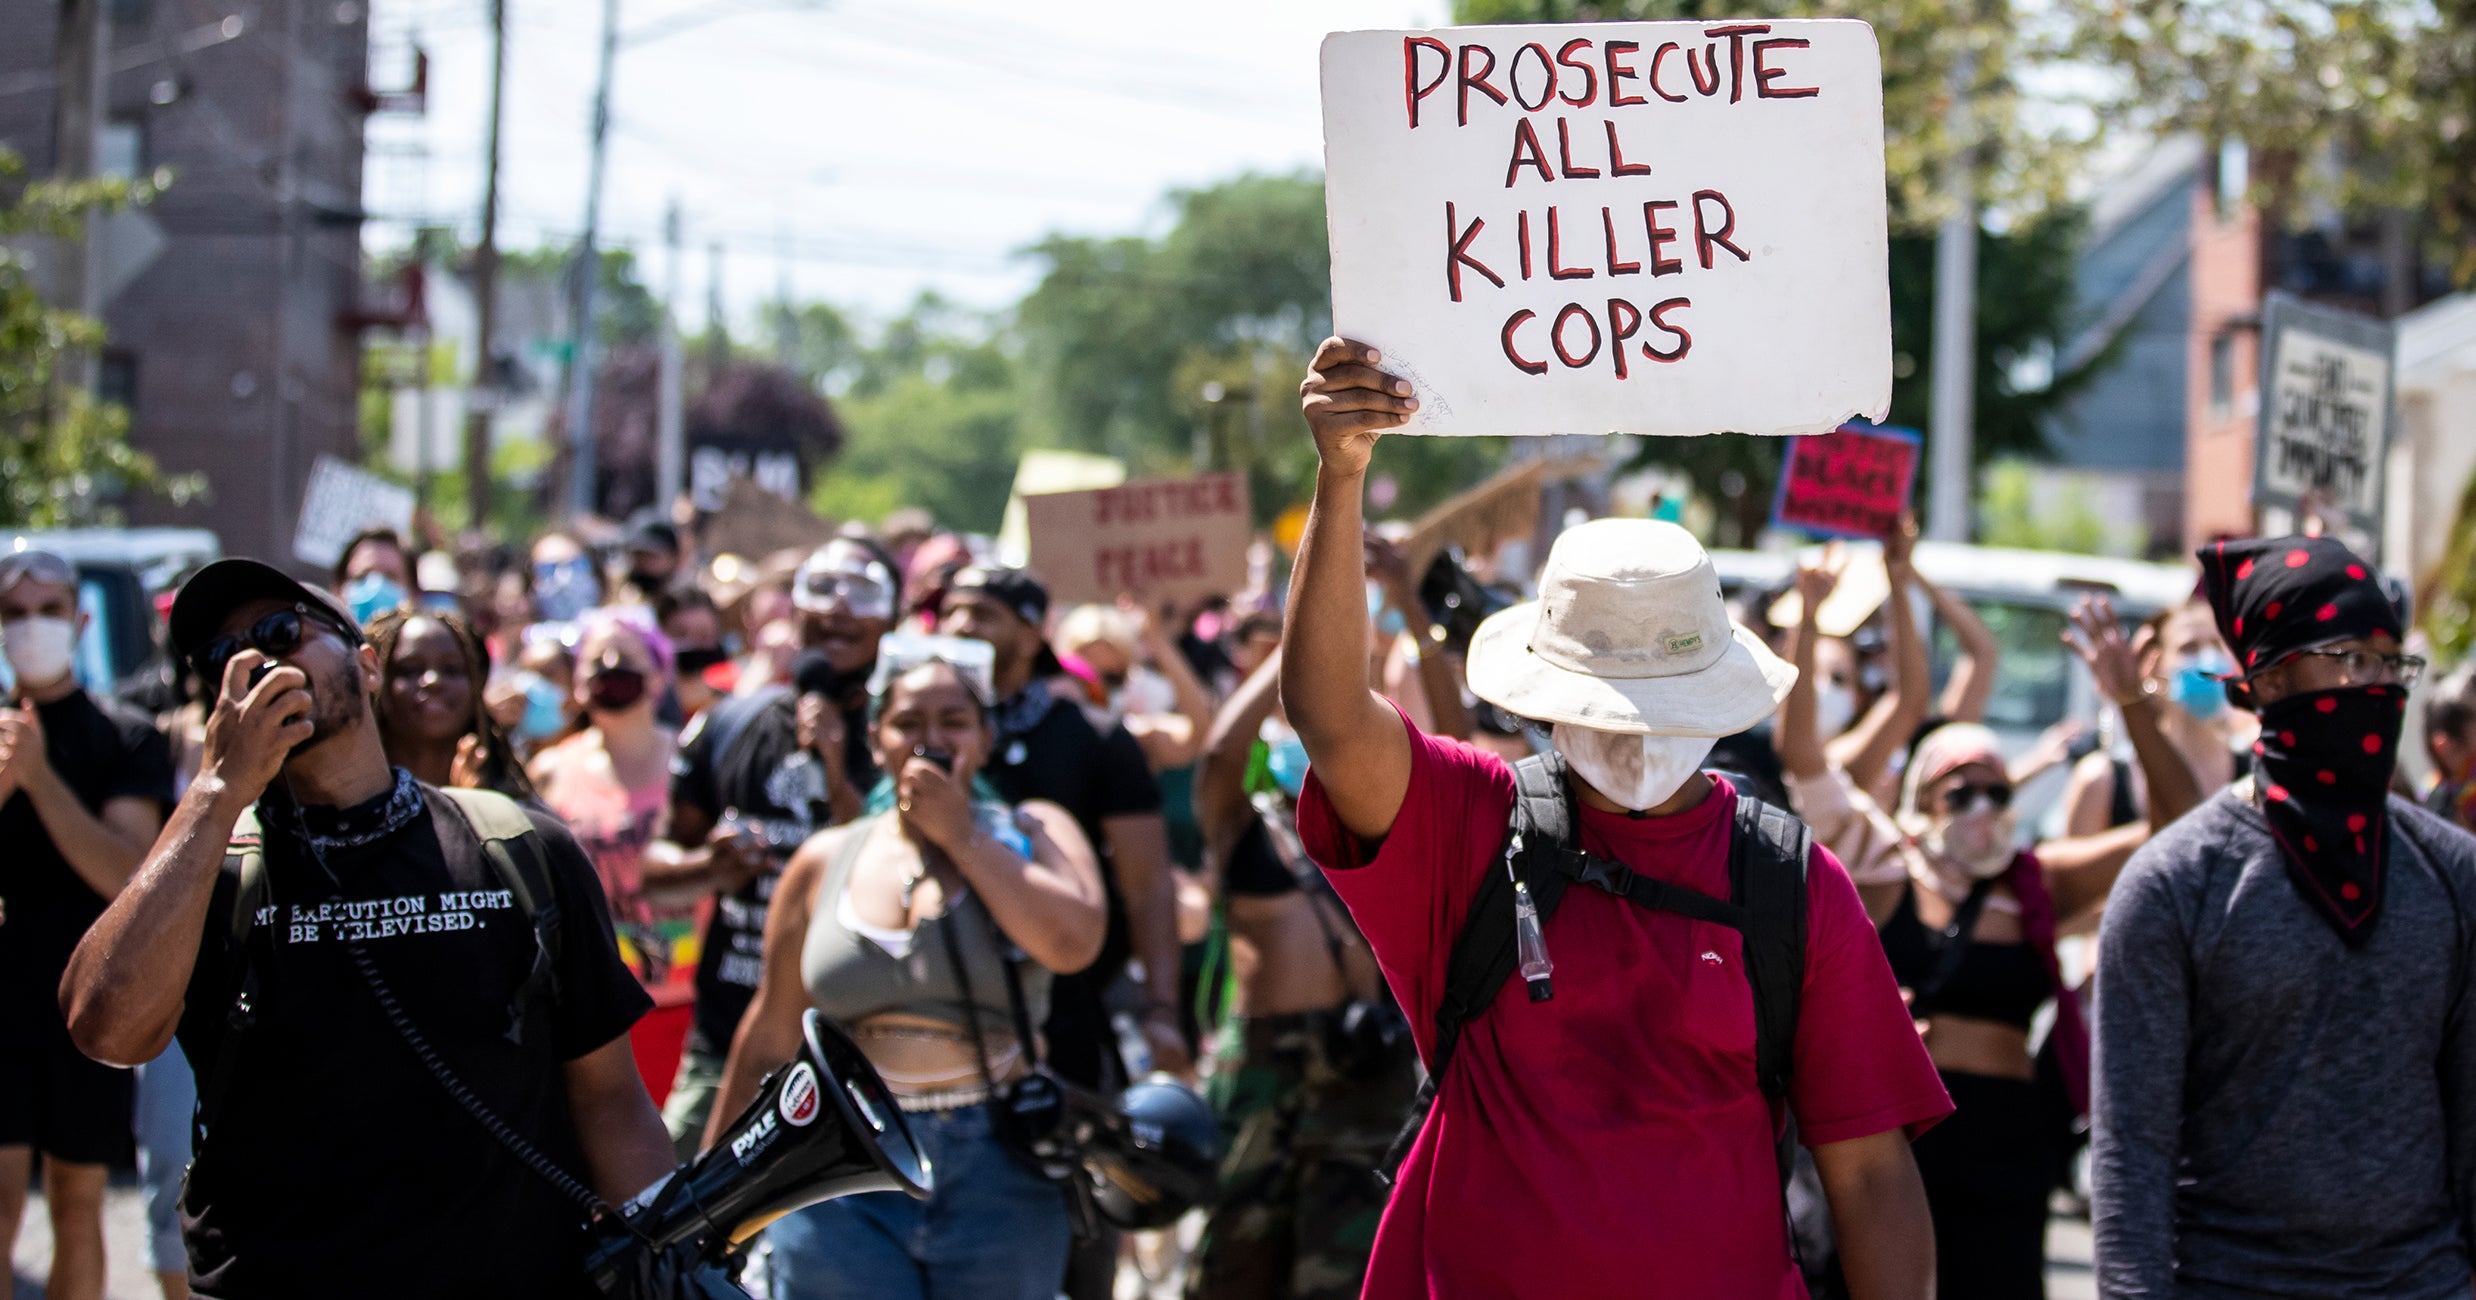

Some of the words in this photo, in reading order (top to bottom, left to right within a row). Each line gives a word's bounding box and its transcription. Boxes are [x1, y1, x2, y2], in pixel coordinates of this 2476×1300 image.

[1404, 25, 1820, 129] PROSECUTE
[1505, 117, 1651, 188] ALL
[1446, 189, 1751, 302] KILLER
[1501, 297, 1692, 380] COPS
[288, 925, 320, 943] BE
[290, 896, 426, 924] EXECUTION
[439, 889, 513, 912] MIGHT
[731, 1110, 777, 1158] PYLE
